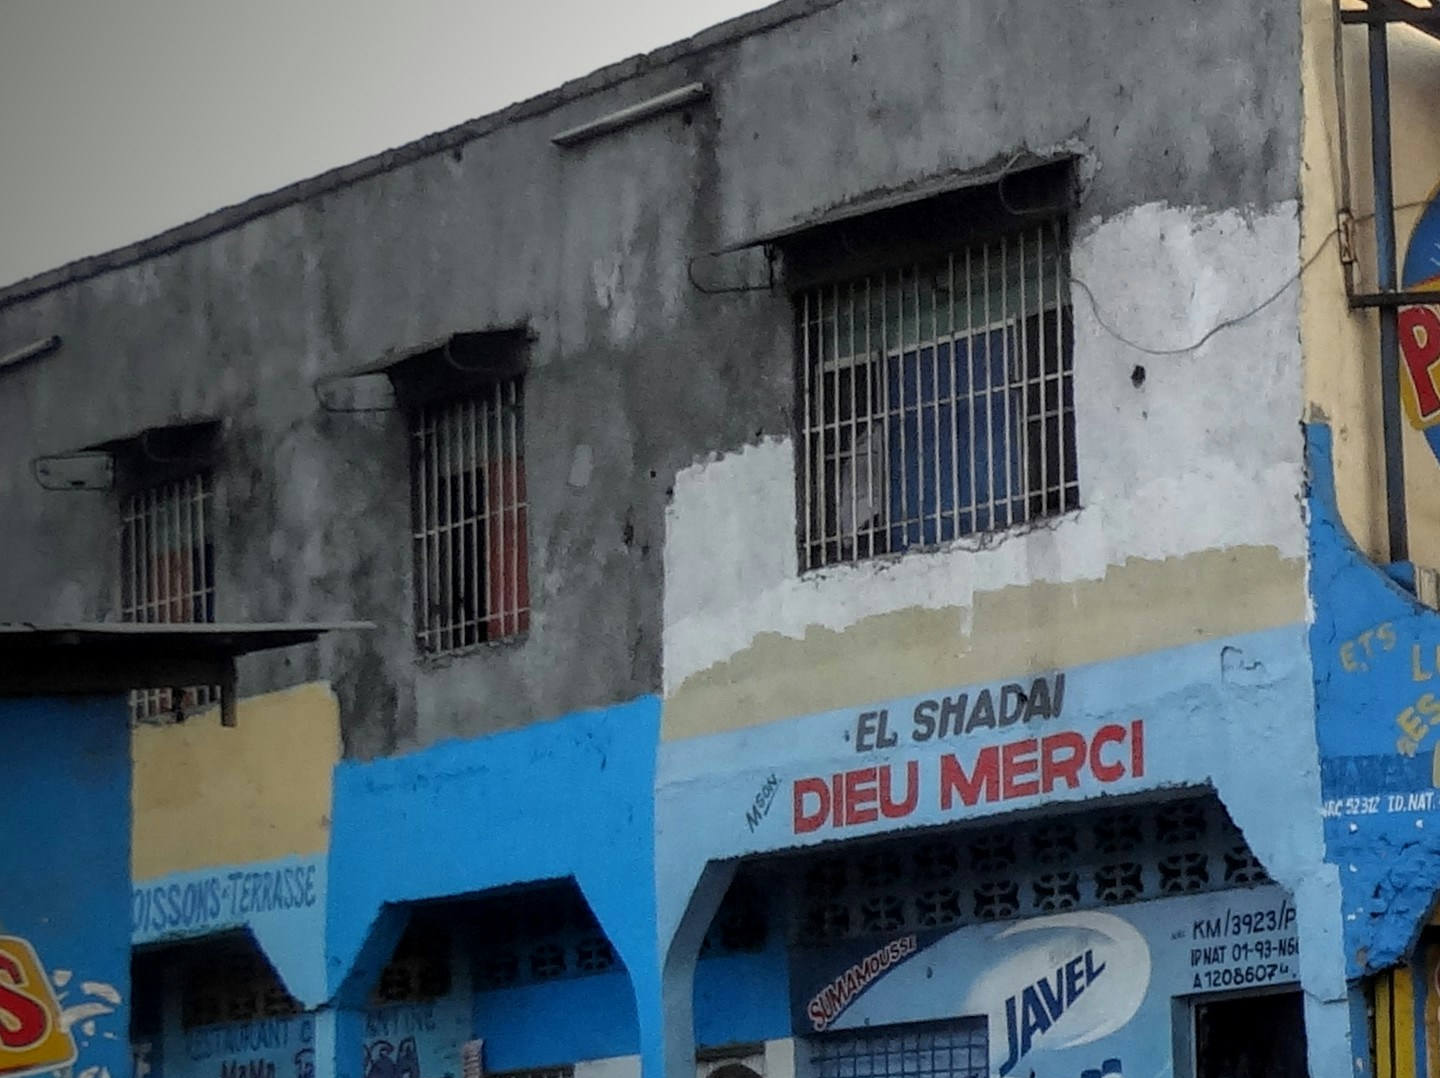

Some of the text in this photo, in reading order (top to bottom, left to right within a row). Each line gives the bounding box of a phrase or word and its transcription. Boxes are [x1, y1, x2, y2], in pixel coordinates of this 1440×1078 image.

[912, 673, 1066, 741] SHADAI
[793, 759, 919, 835] DIEU
[940, 718, 1145, 811] MERCI
[1000, 949, 1107, 1078] JAVEL
